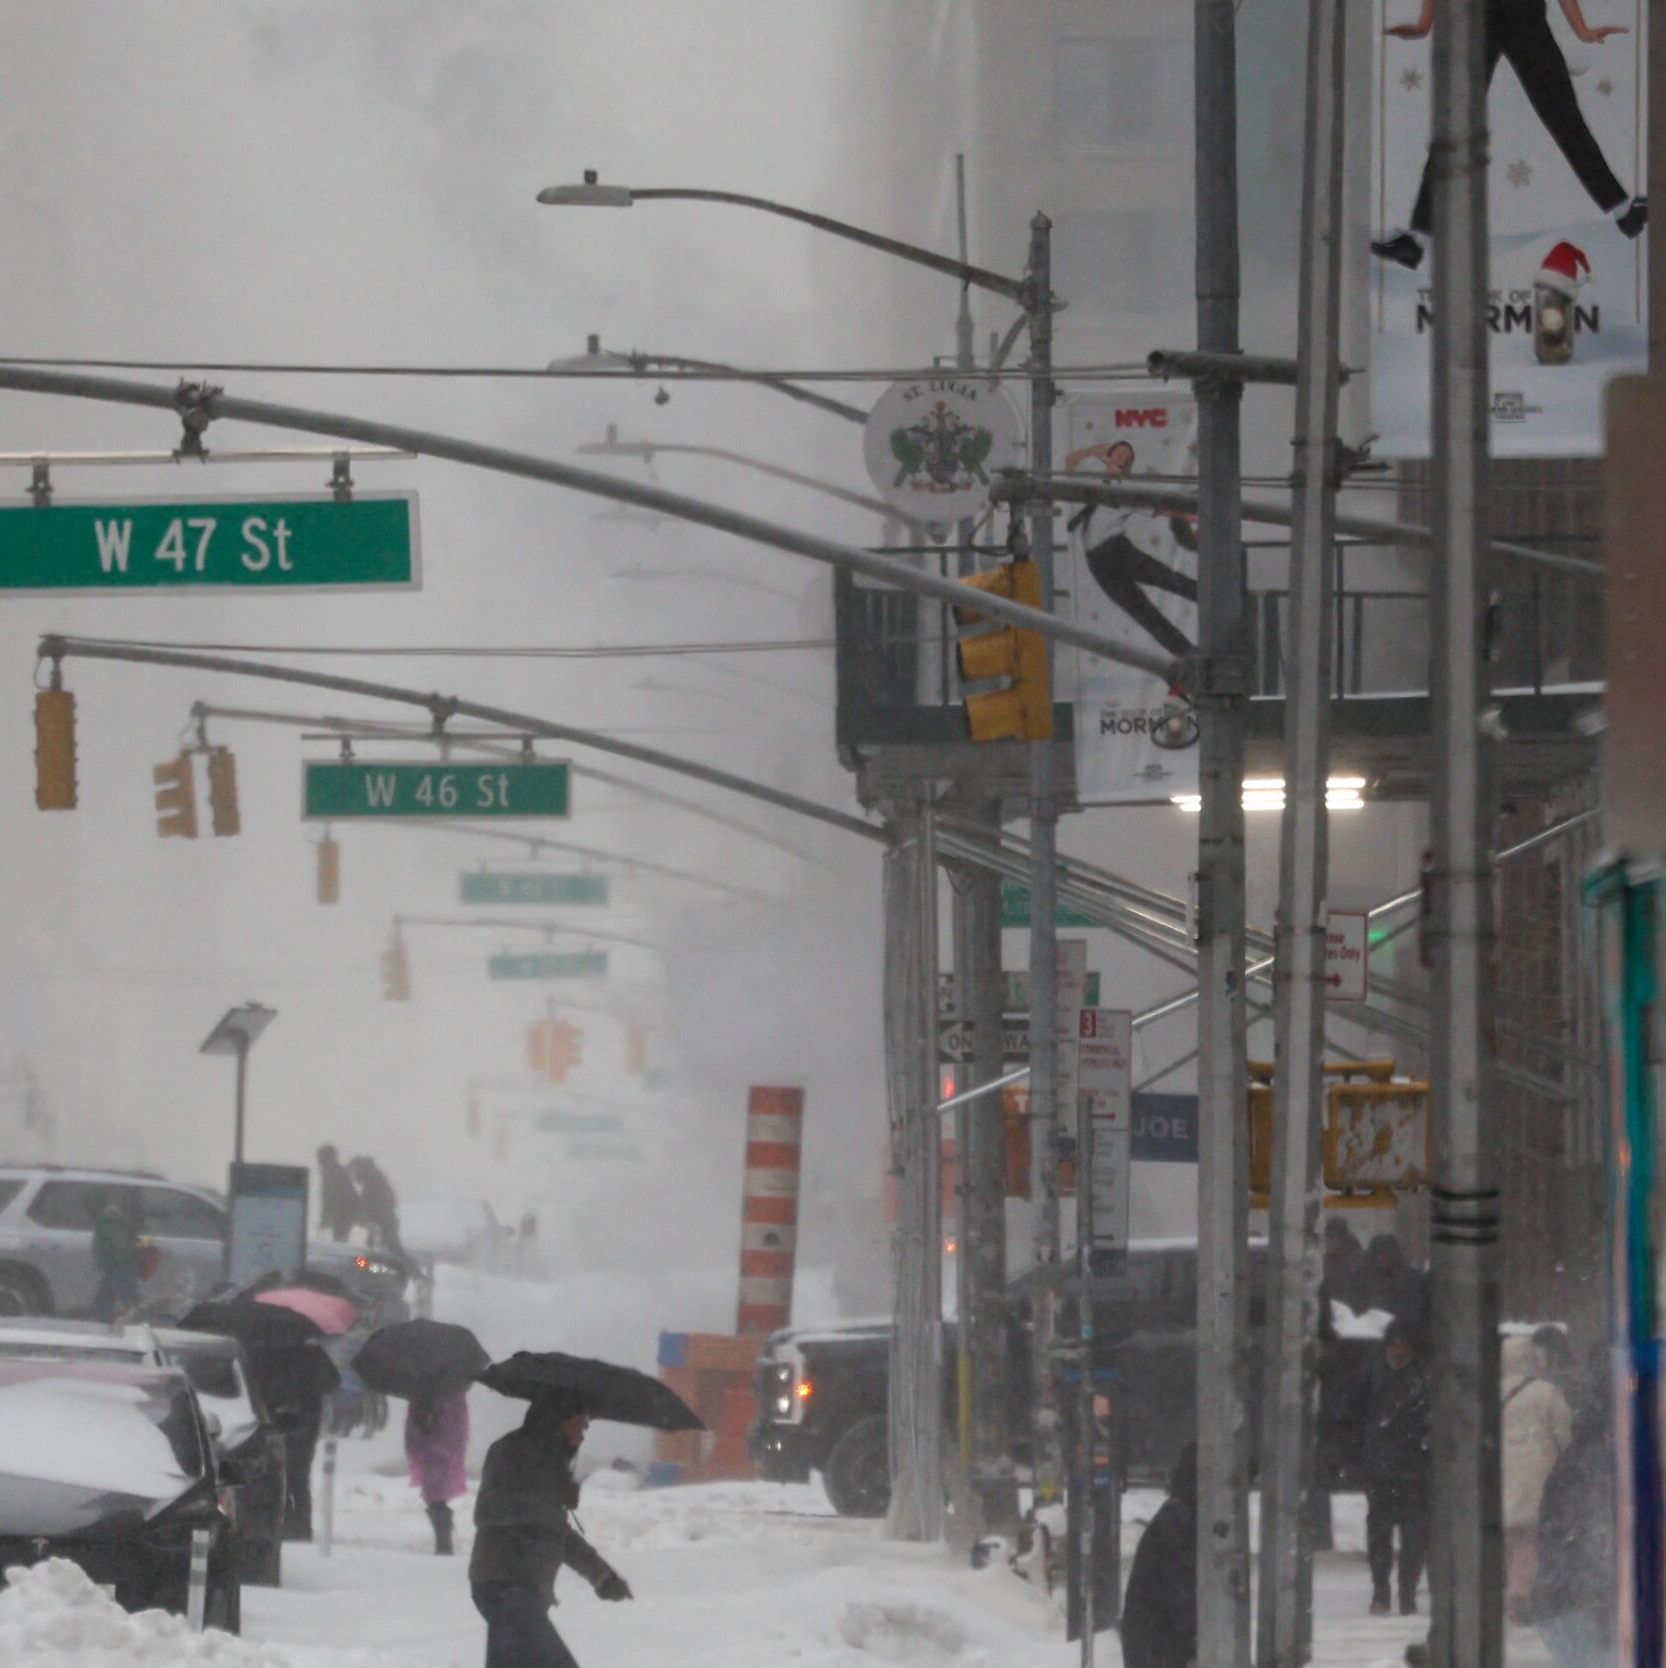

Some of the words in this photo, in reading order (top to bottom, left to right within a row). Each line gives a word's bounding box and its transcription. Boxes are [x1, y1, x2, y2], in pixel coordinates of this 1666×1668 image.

[1115, 407, 1168, 428] NYC
[95, 518, 133, 572] W
[154, 517, 217, 572] 47
[241, 516, 294, 572] St
[365, 773, 397, 807] W
[415, 773, 458, 808] 46
[476, 773, 510, 808] St
[948, 1033, 973, 1050] ON
[1003, 1032, 1030, 1050] WA
[1133, 1117, 1189, 1139] JOE
